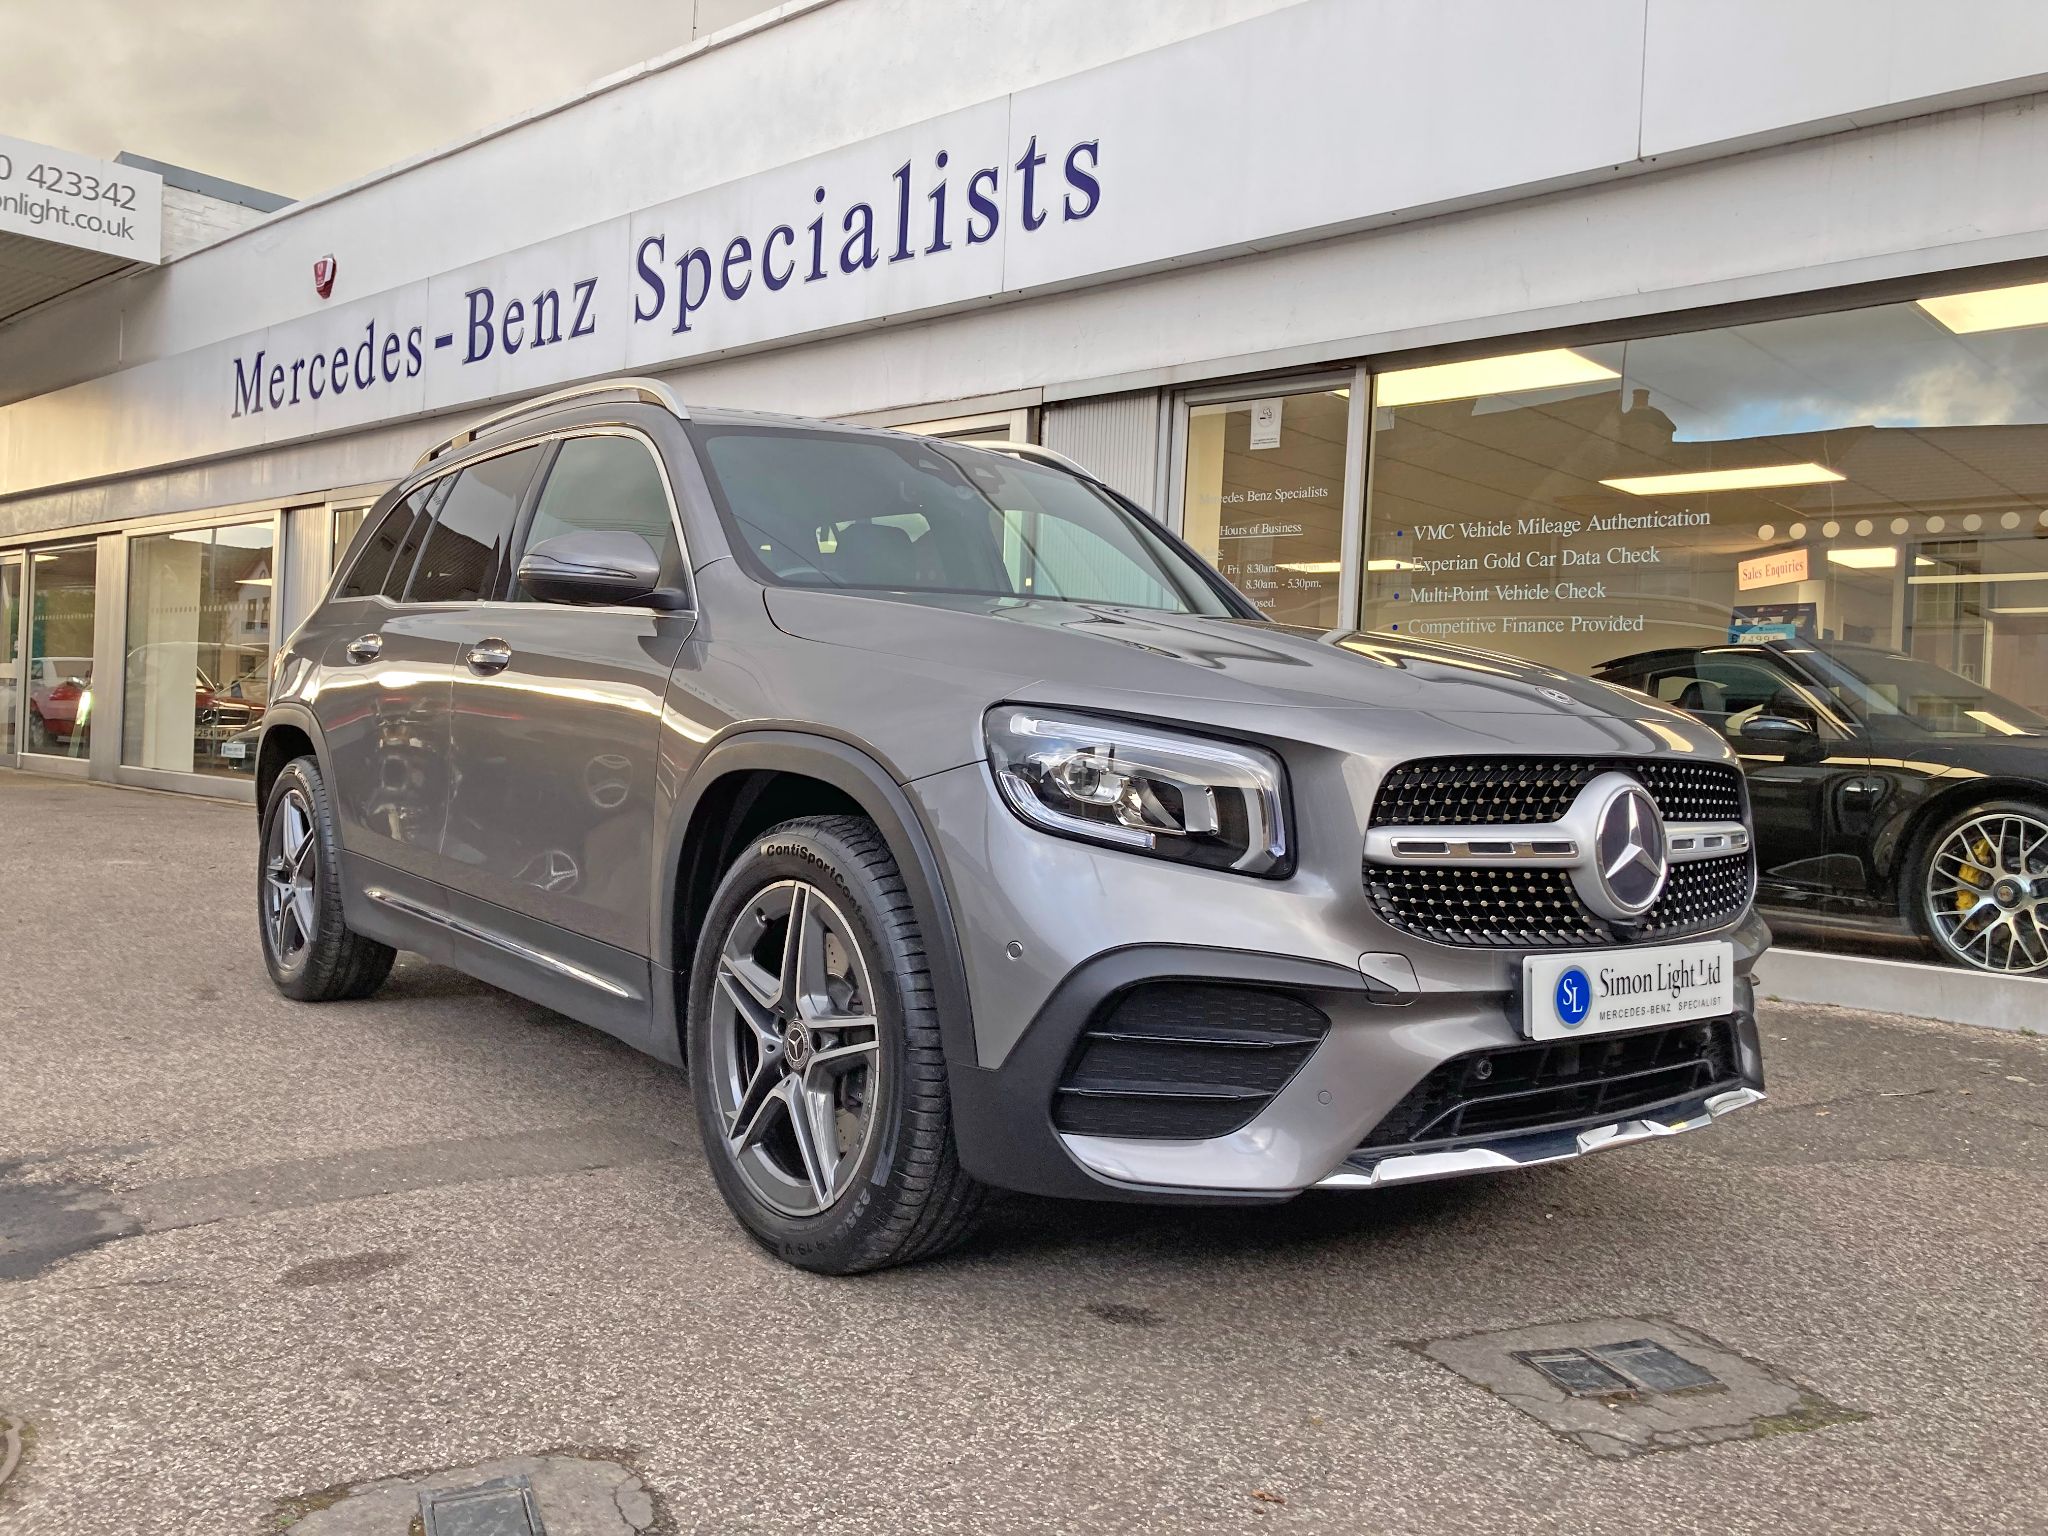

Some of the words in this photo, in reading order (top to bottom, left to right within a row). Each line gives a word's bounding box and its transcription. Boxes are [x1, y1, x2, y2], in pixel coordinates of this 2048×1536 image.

[27, 164, 136, 212] 423342
[0, 192, 134, 241] nlight.co.uk
[231, 276, 599, 419] Mercedes-Benz
[634, 135, 1101, 336] Specialists
[1200, 492, 1244, 504] Medes
[1247, 491, 1272, 502] Benz
[1275, 486, 1329, 502] Specialists
[1219, 525, 1247, 536] Hours
[1249, 523, 1260, 535] of
[1262, 522, 1302, 535] Business
[1414, 523, 1455, 541] VMC
[1459, 521, 1512, 538] Vehicle
[1517, 518, 1581, 537] Mileage
[1586, 509, 1711, 532] Authentication
[1411, 554, 1478, 576] Experian
[1484, 552, 1521, 569] Gold
[1526, 551, 1557, 567] Car
[1562, 549, 1601, 566] Data
[1607, 546, 1661, 564] Check
[1743, 567, 1763, 581] Sales
[1766, 559, 1805, 578] Enquiries
[1246, 578, 1278, 590] 8.30am.
[1287, 578, 1322, 591] 5.30pm.
[1410, 586, 1490, 603] Multi-Point
[1495, 583, 1549, 600] Vehicle
[1555, 582, 1607, 599] Check
[1408, 617, 1496, 638] Competitive
[1502, 617, 1564, 633] Finance
[1570, 615, 1644, 632] Provided
[1562, 978, 1583, 1014] SL
[1600, 968, 1652, 998] Simon
[1657, 959, 1695, 998] Light
[1699, 955, 1721, 986] Ltd
[1600, 1003, 1671, 1020] MERCEDES-BENZ
[1678, 996, 1722, 1011] SPECIALIST
